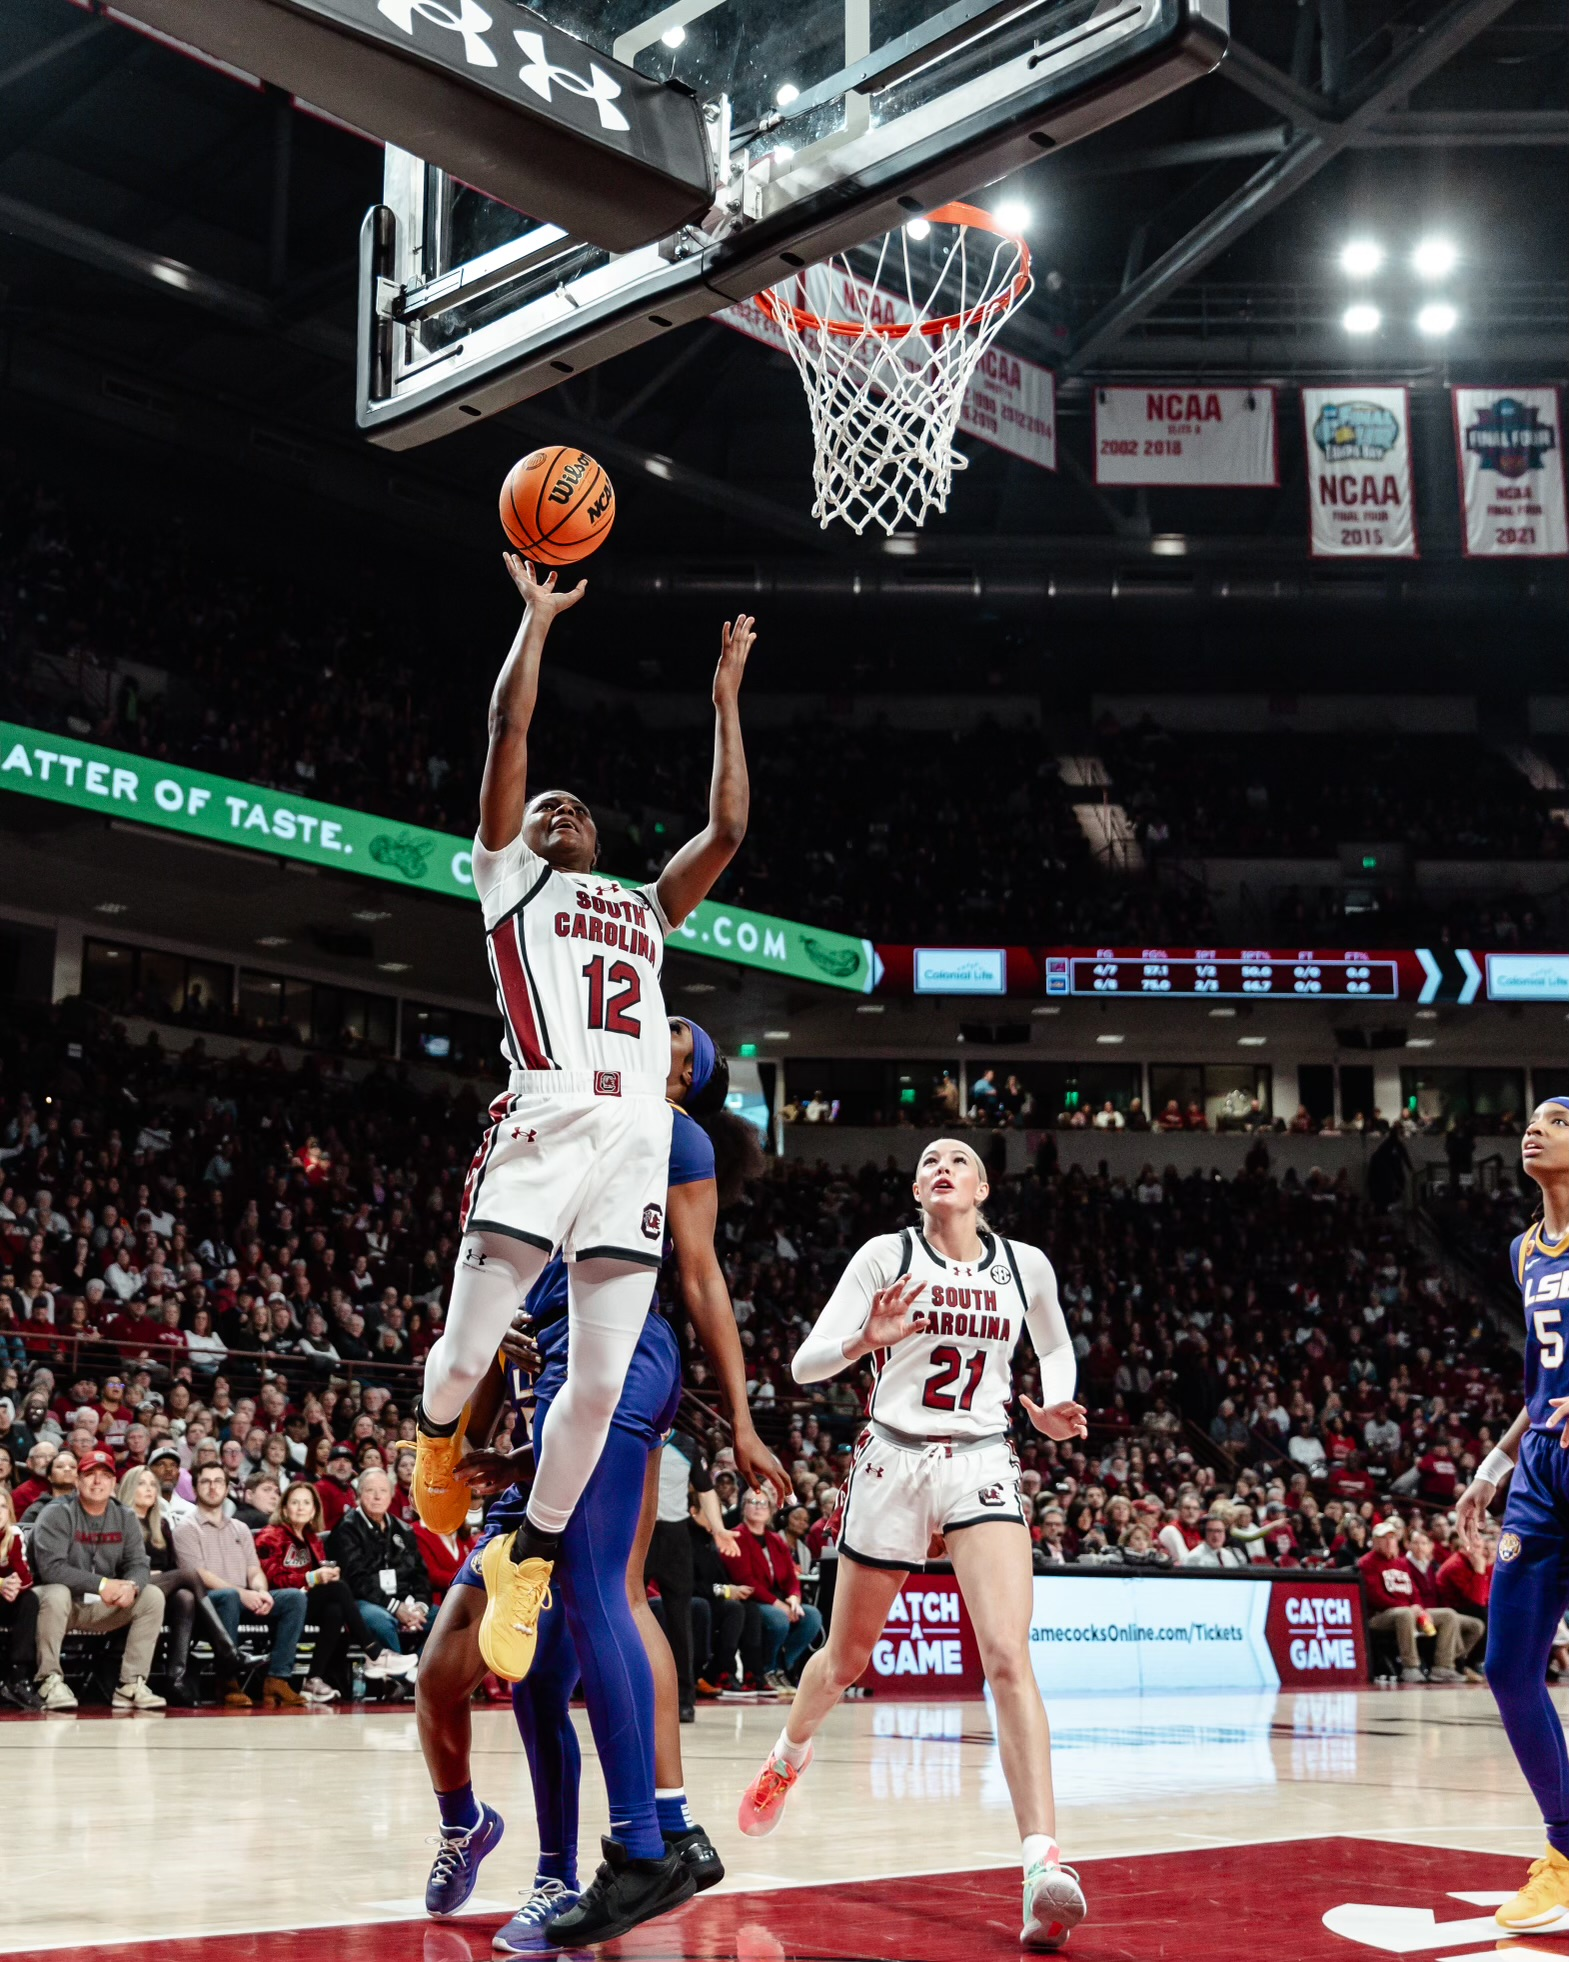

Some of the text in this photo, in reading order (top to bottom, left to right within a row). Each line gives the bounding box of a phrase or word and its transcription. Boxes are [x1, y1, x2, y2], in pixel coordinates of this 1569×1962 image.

[1147, 393, 1222, 423] NCAA
[1101, 440, 1183, 456] 2002 2018
[548, 453, 592, 505] Wilson
[1319, 475, 1401, 506] NCAA
[1341, 528, 1384, 546] 2015
[1496, 527, 1536, 545] 2021
[154, 779, 211, 816] OF
[226, 795, 353, 855] TASTE.
[576, 889, 647, 930] SOUTH
[554, 911, 657, 969] CAROLINA
[923, 969, 995, 980] Colonial Life
[1093, 964, 1119, 977] 4/7
[582, 953, 642, 1040] 12
[991, 1267, 1012, 1284] SEC
[931, 1284, 998, 1312] SOUTH
[1533, 1308, 1564, 1369] 5
[922, 1344, 988, 1412] 21
[888, 1591, 960, 1623] ATCH
[1285, 1597, 1352, 1625] CATCH
[910, 1622, 924, 1640] A
[1028, 1622, 1243, 1644] amecocksOnline.com/Tickets
[1315, 1623, 1328, 1640] A
[872, 1639, 963, 1677] GAME
[1289, 1638, 1356, 1670] GAME
